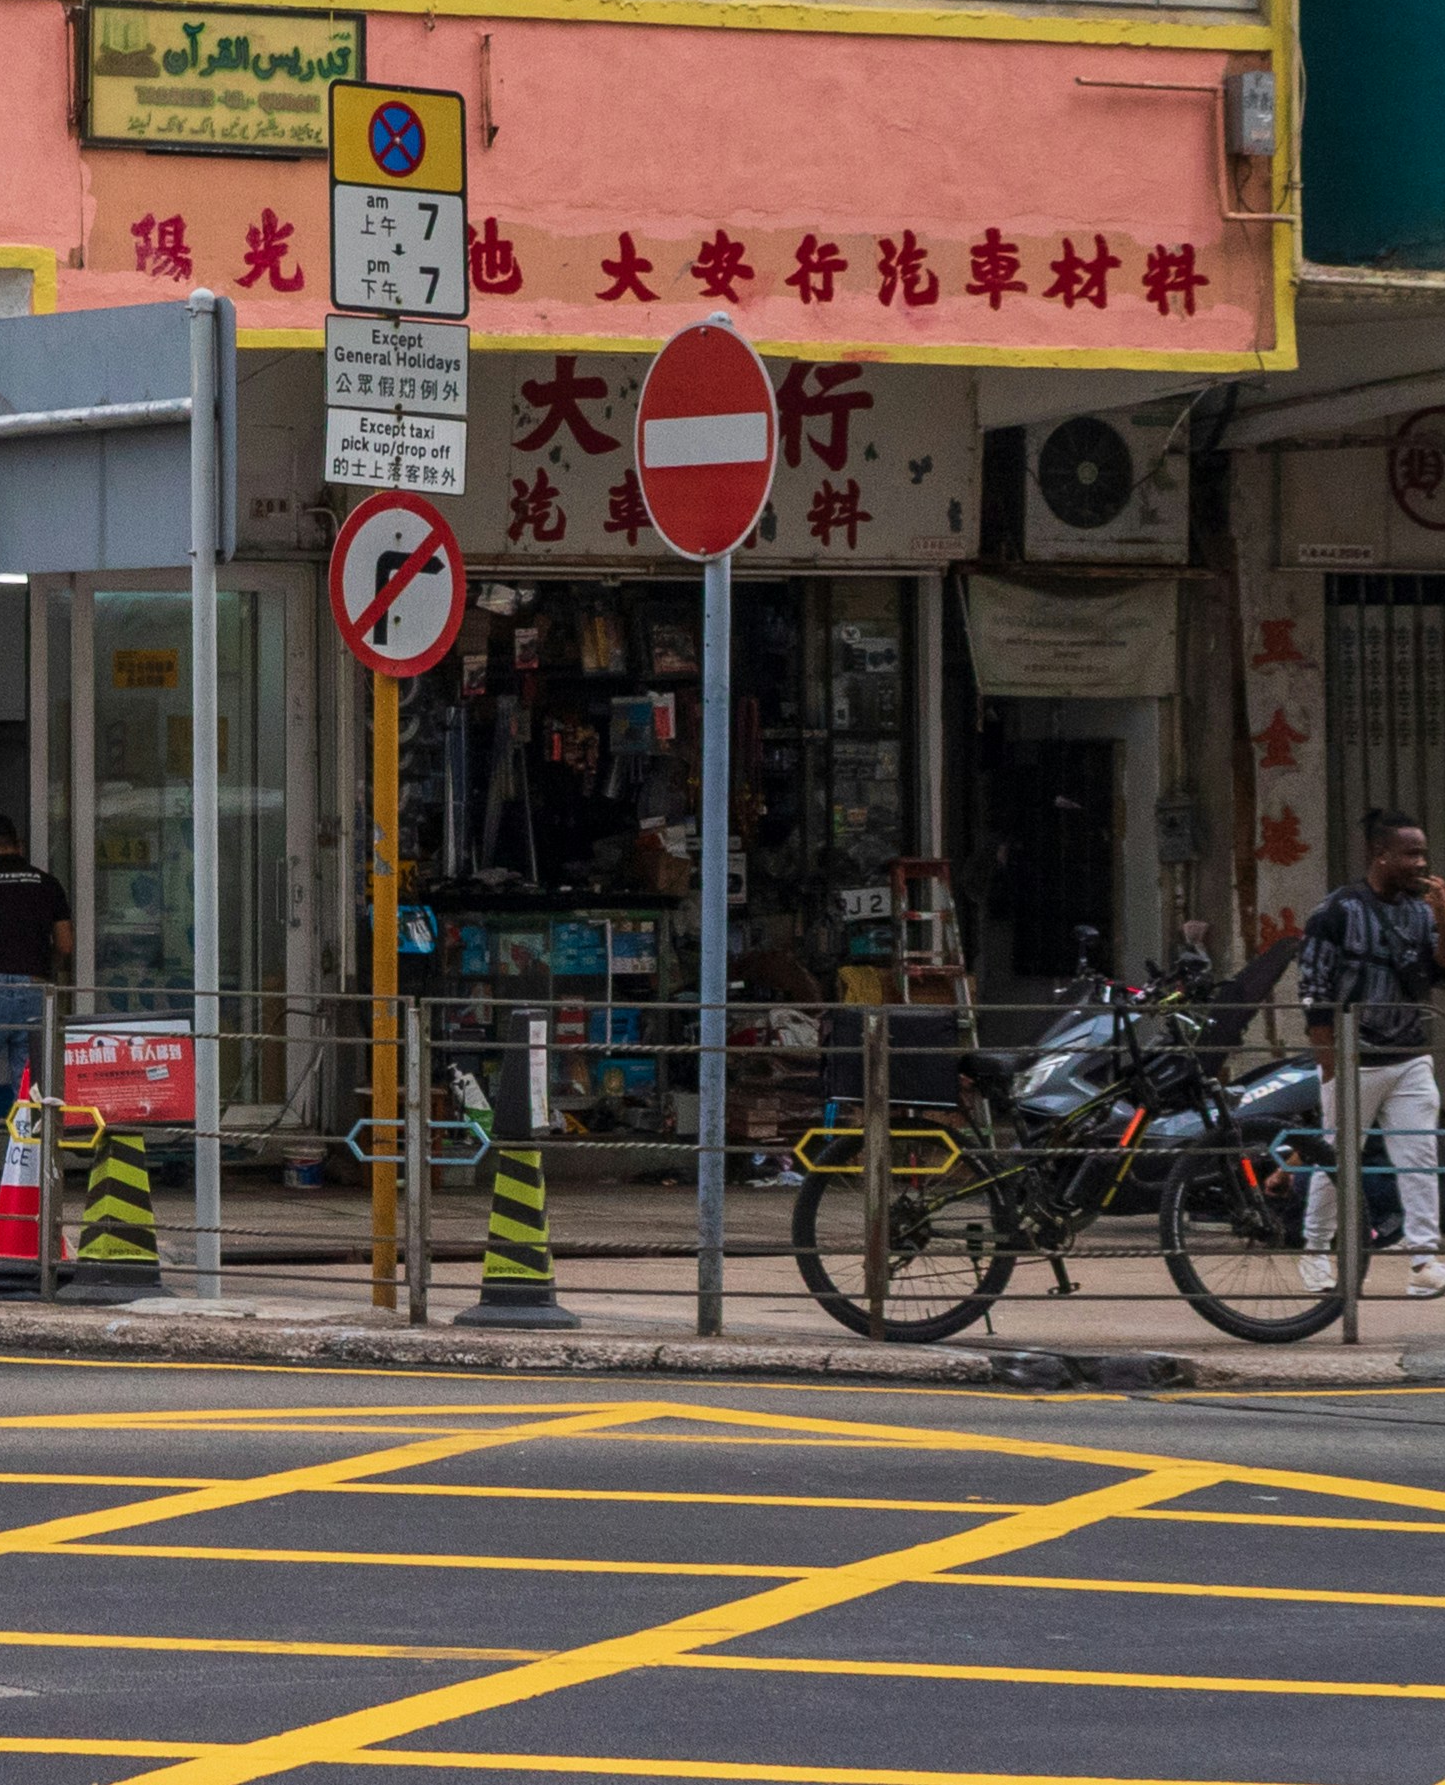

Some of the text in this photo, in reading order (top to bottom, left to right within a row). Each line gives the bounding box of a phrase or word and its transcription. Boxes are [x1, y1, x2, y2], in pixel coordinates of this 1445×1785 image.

[359, 214, 398, 238] 上午
[366, 196, 440, 241] am 7
[360, 278, 398, 302] 下午
[366, 260, 441, 305] pm 7
[372, 328, 424, 350] Except
[334, 346, 462, 374] General Holidays
[335, 372, 461, 403] 公眾假期例外
[511, 355, 874, 472] 大行
[359, 417, 436, 441] Except taxi
[341, 434, 452, 461] pick up/drop off
[332, 457, 458, 487] 的士上落客除外
